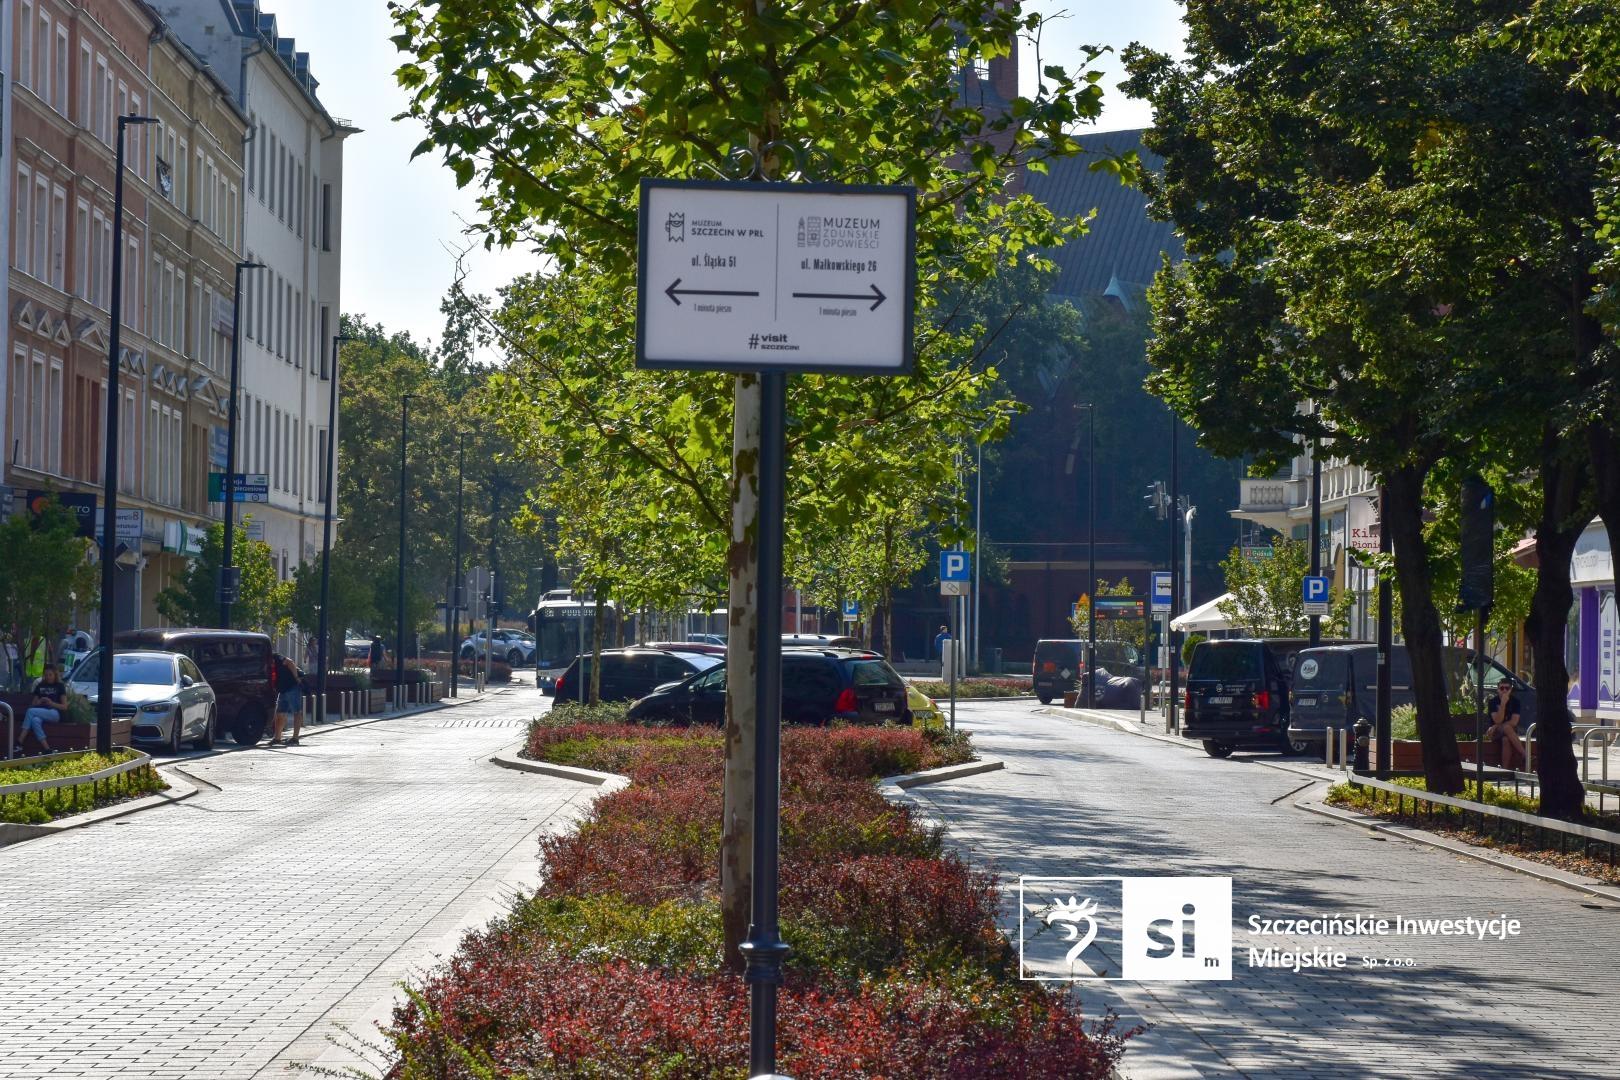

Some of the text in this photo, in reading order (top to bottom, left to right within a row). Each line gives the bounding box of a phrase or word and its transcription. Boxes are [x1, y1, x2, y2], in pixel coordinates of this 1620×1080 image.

[691, 219, 722, 227] MUZEUM
[823, 217, 880, 229] MUZEUM
[691, 227, 764, 238] SZCZECIN W PRL
[691, 253, 737, 269] ul. Śląska 51
[801, 258, 811, 270] ul.
[867, 260, 878, 272] 26
[946, 555, 964, 578] P
[1309, 580, 1324, 600] P
